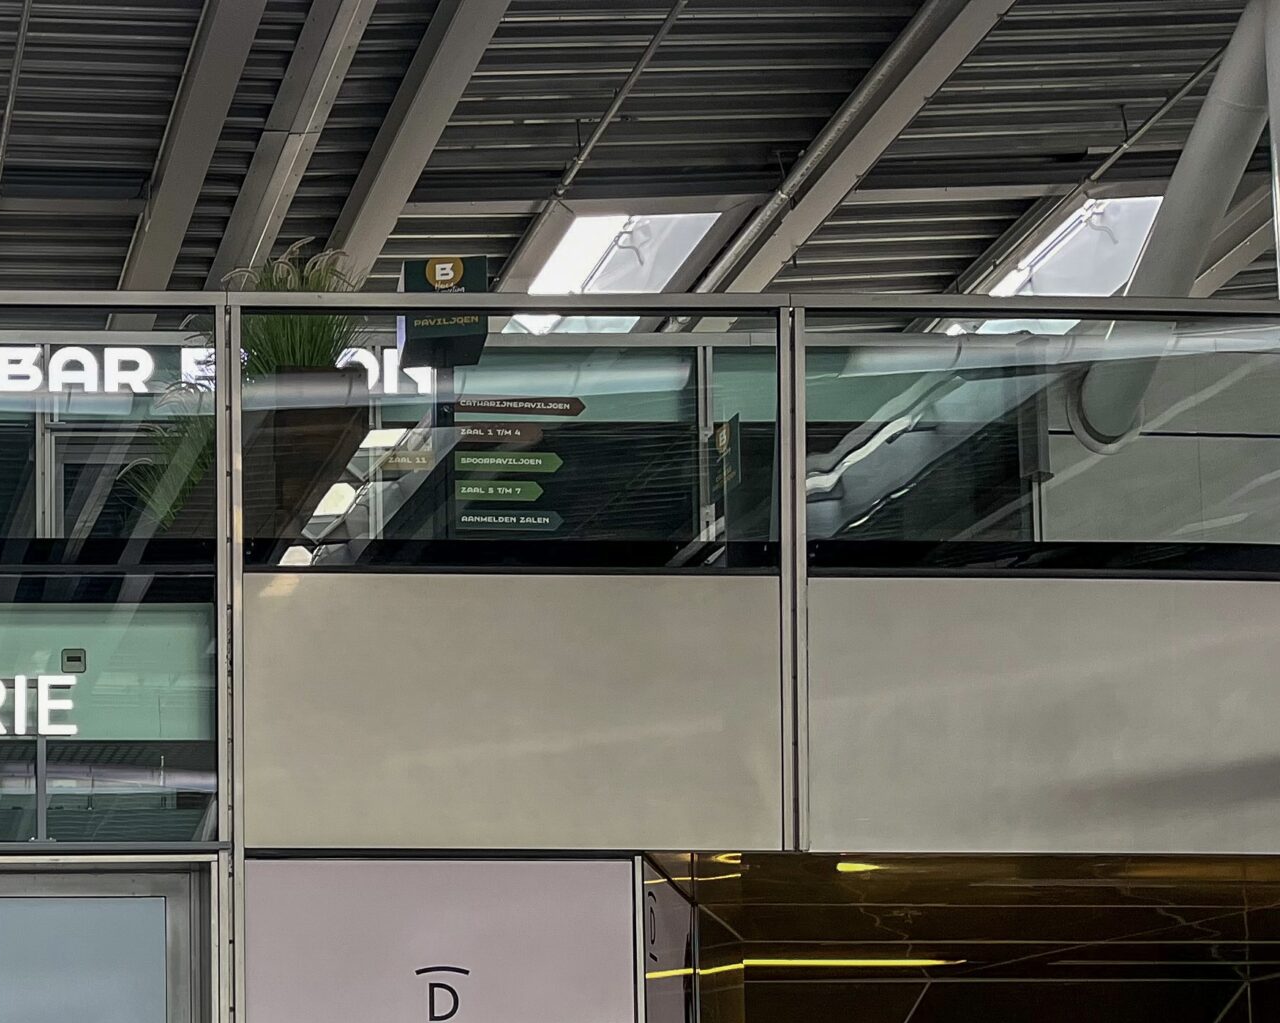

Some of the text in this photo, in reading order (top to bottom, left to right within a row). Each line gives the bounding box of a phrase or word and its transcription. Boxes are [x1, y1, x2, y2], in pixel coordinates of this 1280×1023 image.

[435, 263, 455, 281] B
[459, 400, 571, 411] CATHARIJNEPAVILJOEN
[460, 428, 485, 437] ZAAL
[487, 429, 494, 437] 1
[496, 429, 513, 437] T/M
[460, 457, 543, 466] SPOORPAVILJOEN
[460, 486, 486, 495] ZAAL
[497, 487, 513, 495] T/M
[515, 487, 522, 496] 7
[460, 515, 551, 525] AANMELDEN ZALEN
[428, 982, 459, 1022] D
